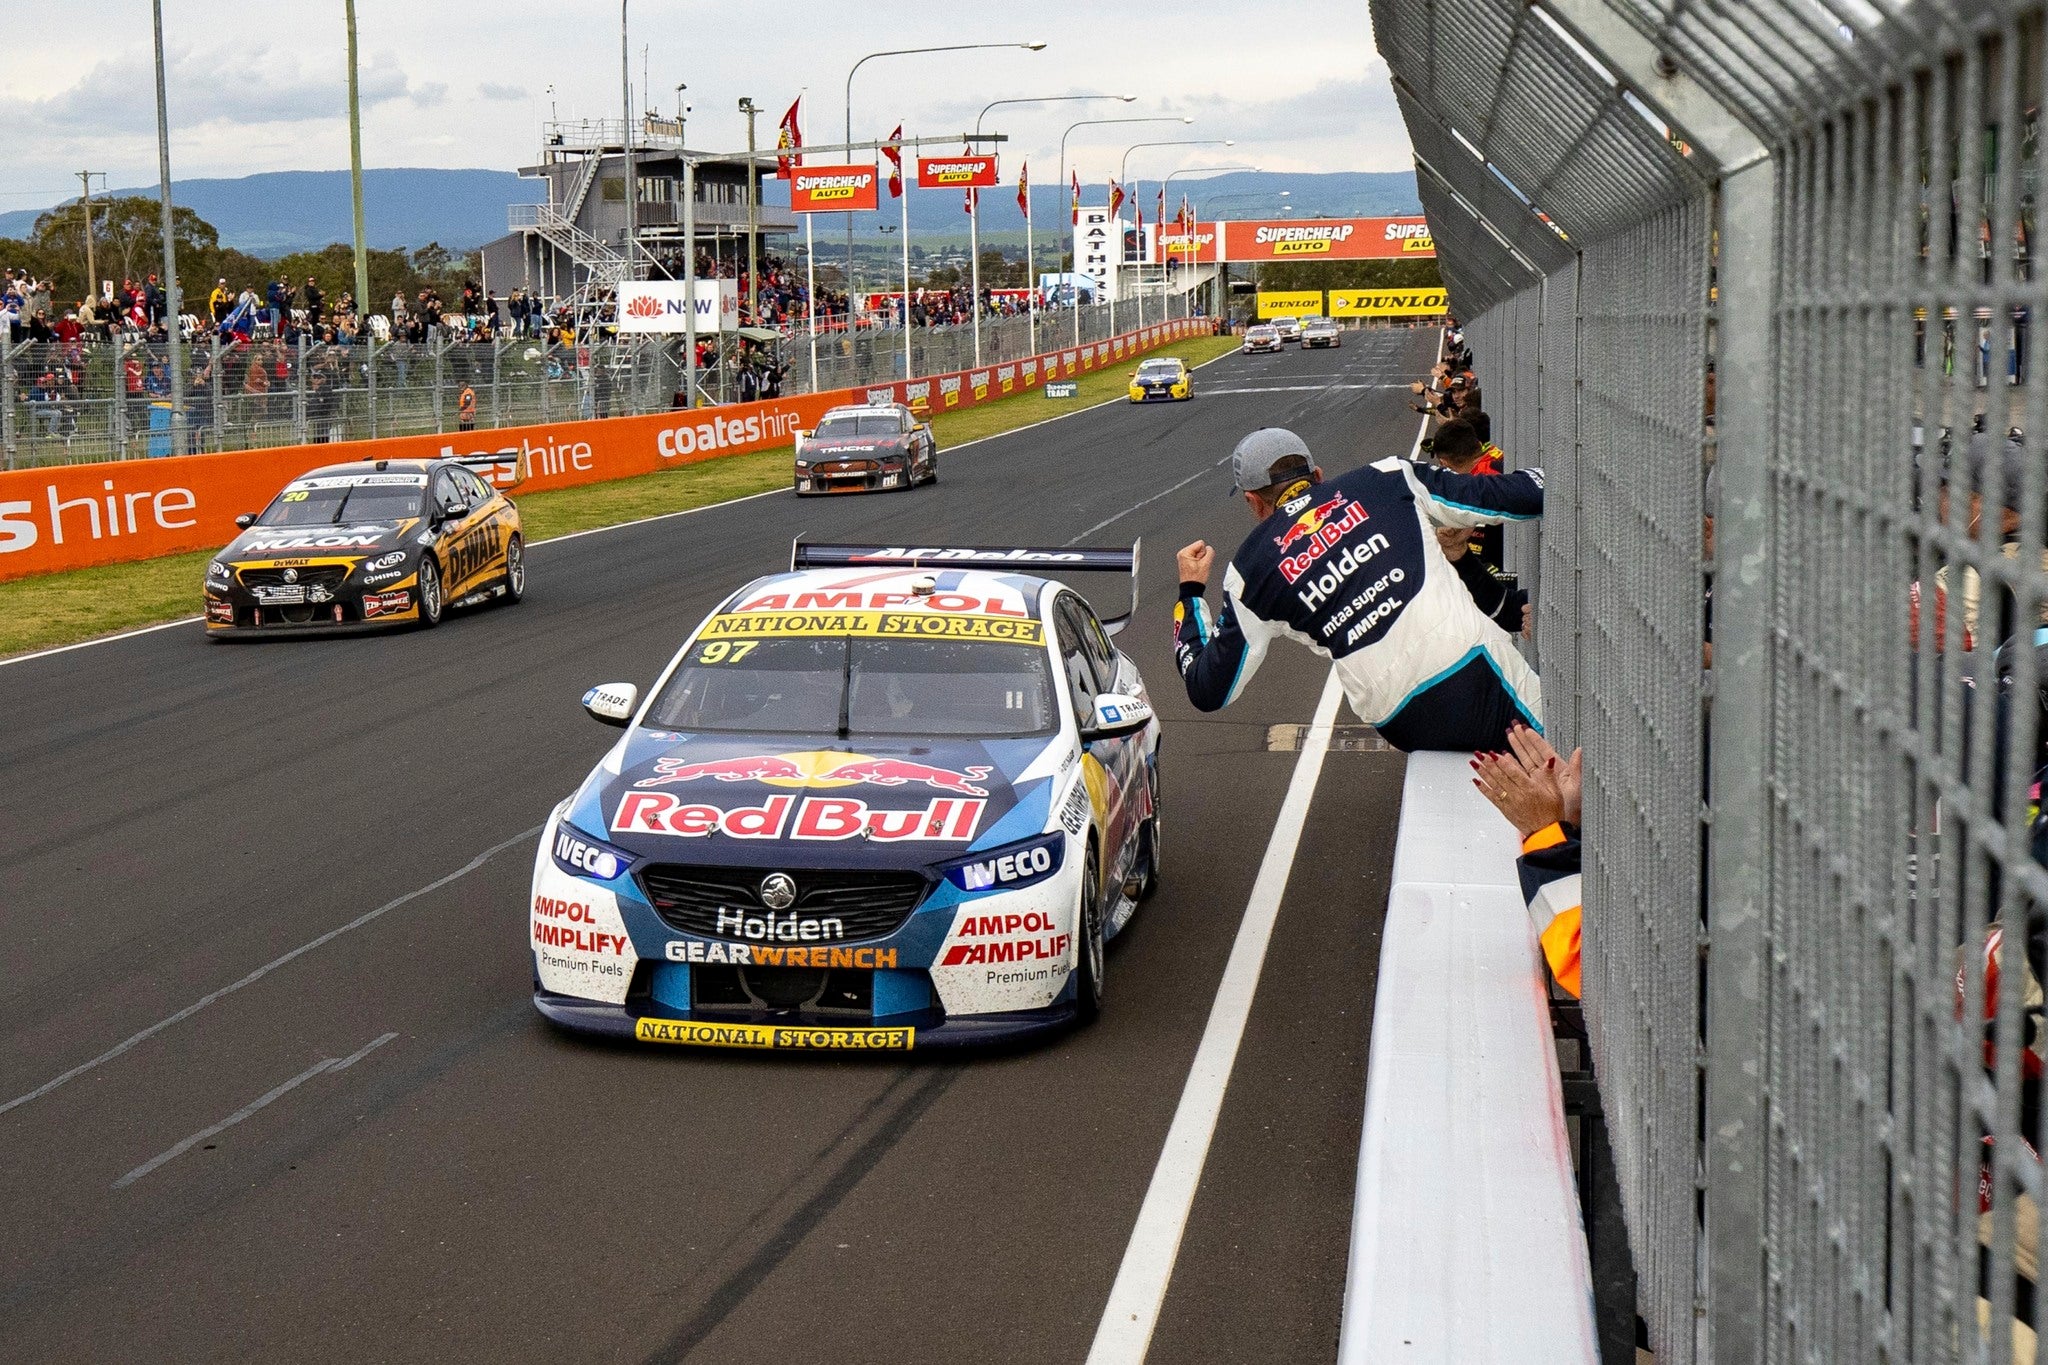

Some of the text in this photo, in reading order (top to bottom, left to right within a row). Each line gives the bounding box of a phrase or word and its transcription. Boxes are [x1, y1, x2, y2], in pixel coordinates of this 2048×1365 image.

[926, 162, 987, 175] SUPERCHEAP
[942, 173, 969, 181] AUTO
[796, 174, 872, 191] SUPERCHEAP
[815, 189, 849, 198] AUTO
[1255, 225, 1354, 243] SUPERCHEAP
[1280, 242, 1324, 252] AUTO
[1269, 300, 1320, 309] DUNLOP
[820, 446, 875, 454] TRUCKS
[282, 491, 310, 503] 20
[1319, 500, 1370, 548] Bull
[242, 534, 384, 552] NULON
[375, 571, 401, 581] HINO
[1298, 533, 1391, 613] Holden
[736, 592, 1026, 617] AMPOL
[1322, 574, 1389, 638] mtaa super
[710, 614, 1035, 641] NATIONAL STORAGE
[1346, 596, 1403, 646] AMPOL
[698, 640, 760, 664] 97
[597, 691, 628, 707] TRADE
[610, 790, 988, 843] Red Bull
[962, 846, 1051, 890] IVECO
[534, 895, 597, 925] AMPOL
[716, 905, 844, 942] Holden
[957, 911, 1055, 938] AMPOL
[534, 920, 628, 956] AMPLIFY
[965, 930, 1074, 965] AMPLIFY
[541, 950, 623, 977] Premium Fuels
[986, 969, 1049, 985] Premium
[640, 1021, 904, 1049] NATIONAL STORAGE
